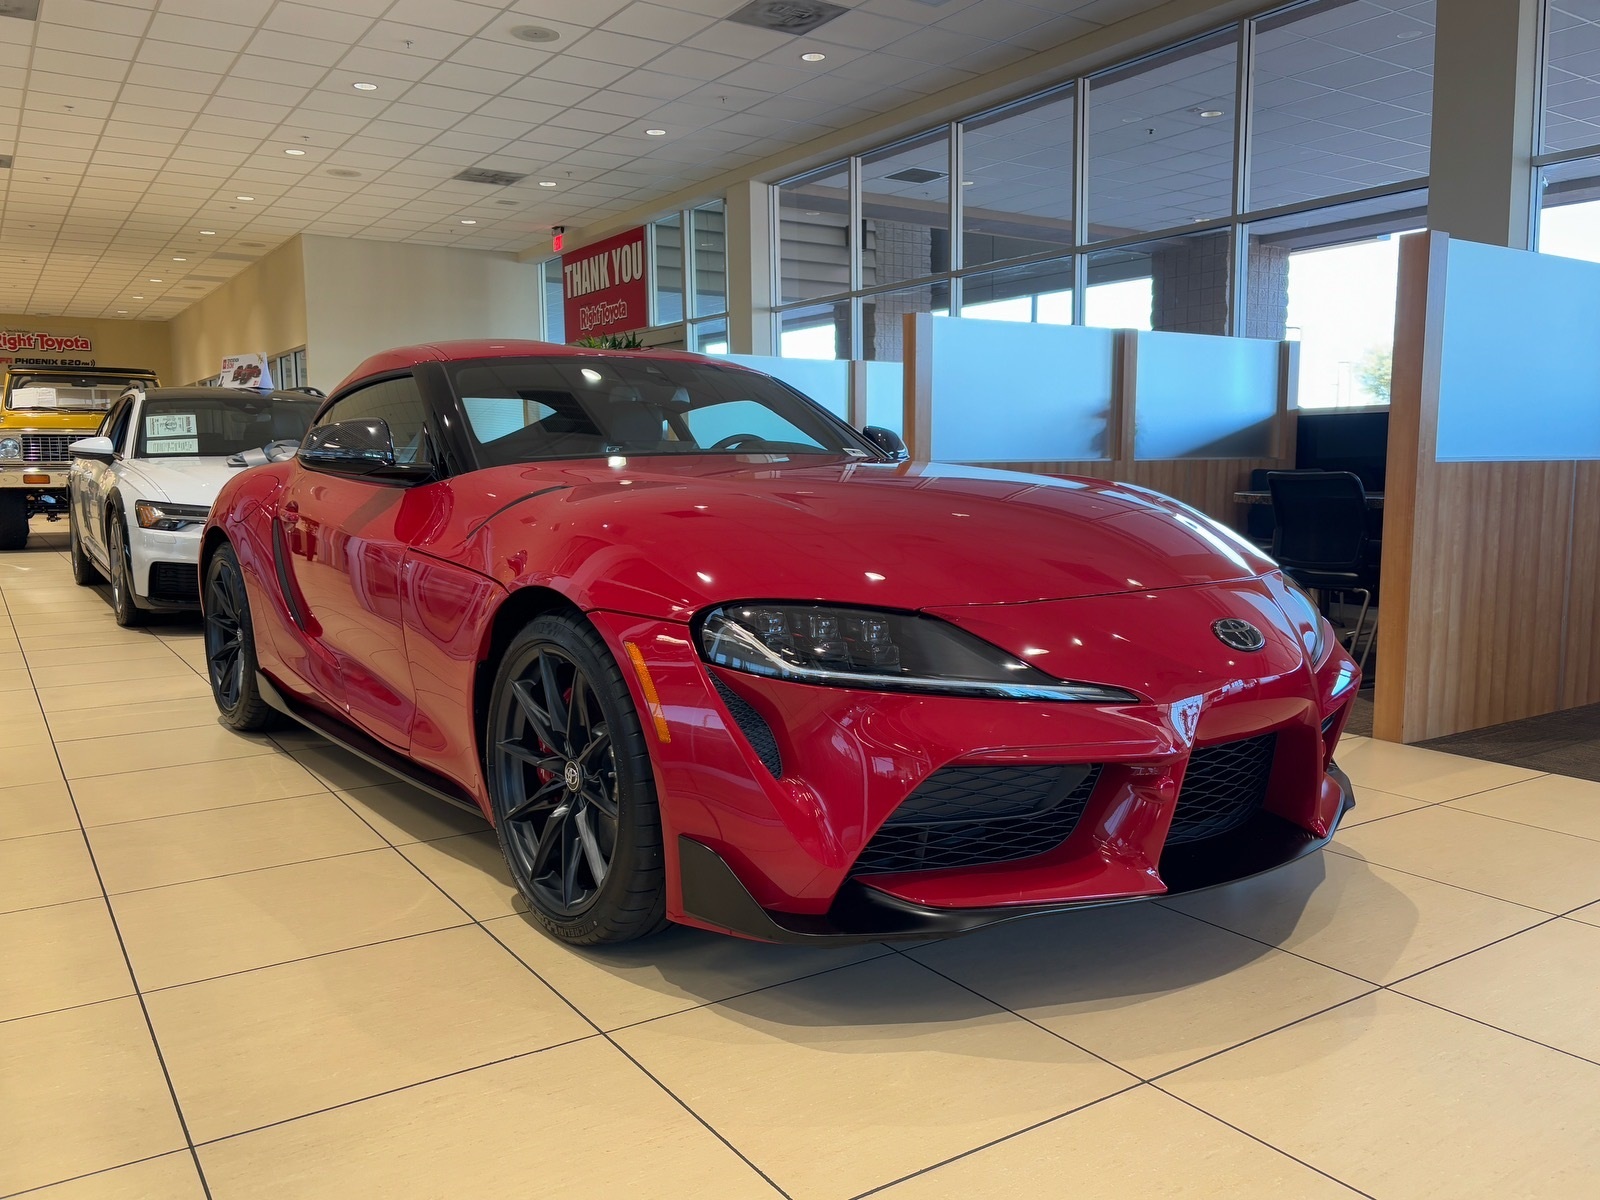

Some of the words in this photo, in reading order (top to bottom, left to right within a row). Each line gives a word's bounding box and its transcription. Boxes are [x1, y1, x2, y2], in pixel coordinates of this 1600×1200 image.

[564, 252, 610, 299] THANK
[612, 240, 643, 286] YOU
[580, 305, 600, 330] Right
[600, 299, 628, 325] Toyota
[35, 333, 91, 352] Toyota
[559, 922, 594, 937] MICHELIN
